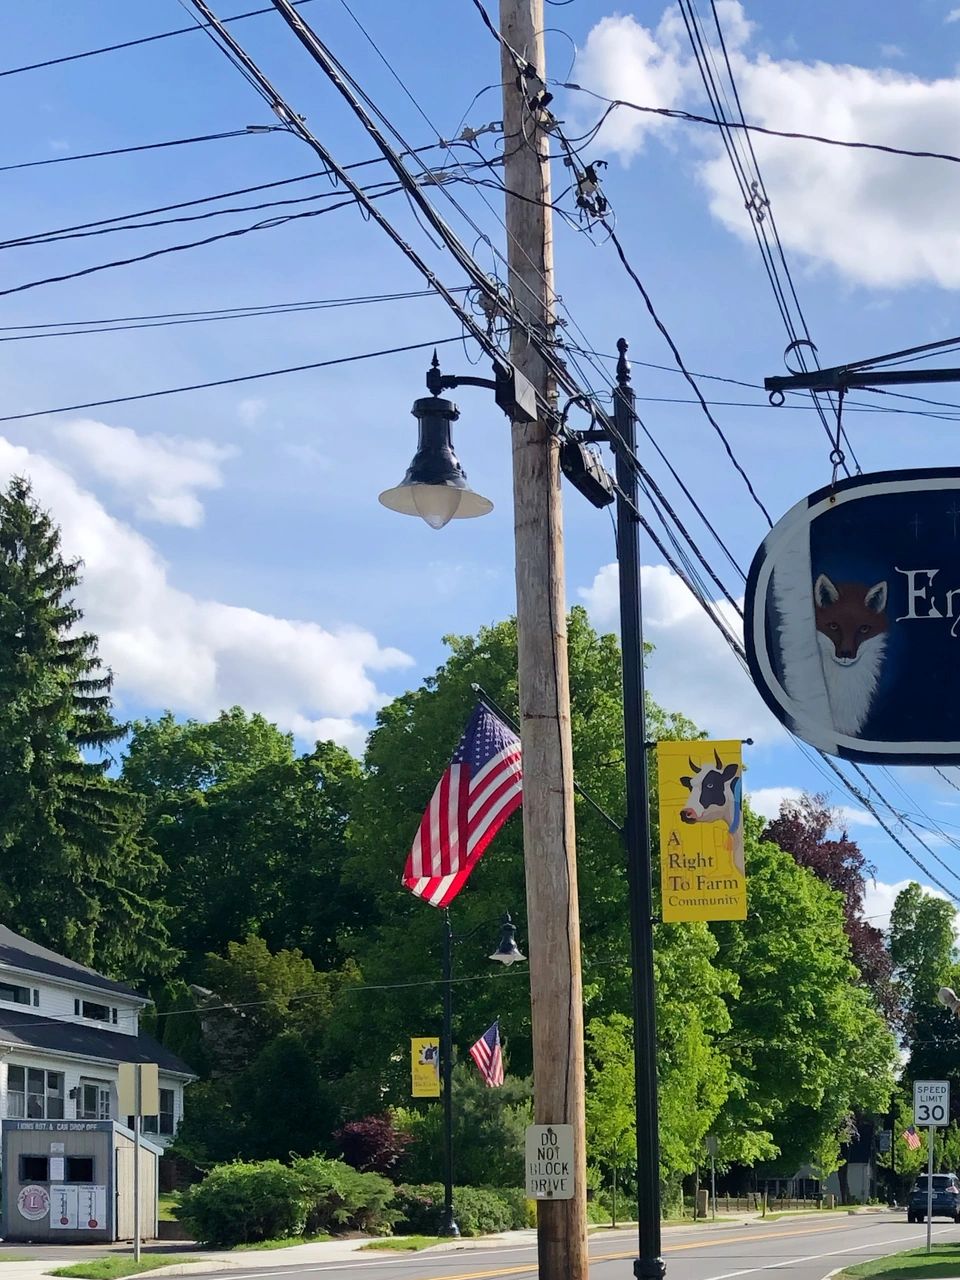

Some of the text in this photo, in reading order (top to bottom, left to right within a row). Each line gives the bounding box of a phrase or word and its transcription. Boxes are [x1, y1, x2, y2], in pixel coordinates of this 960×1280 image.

[667, 831, 681, 846] A
[669, 852, 714, 871] Right
[669, 875, 739, 891] To Farm
[668, 895, 740, 907] Community
[917, 1086, 947, 1094] SPEED
[920, 1095, 943, 1103] LIMIT
[918, 1105, 945, 1121] 30
[541, 1132, 558, 1146] DO
[537, 1146, 560, 1161] NOT
[530, 1162, 569, 1176] BLOCK
[531, 1178, 568, 1192] DRIVE
